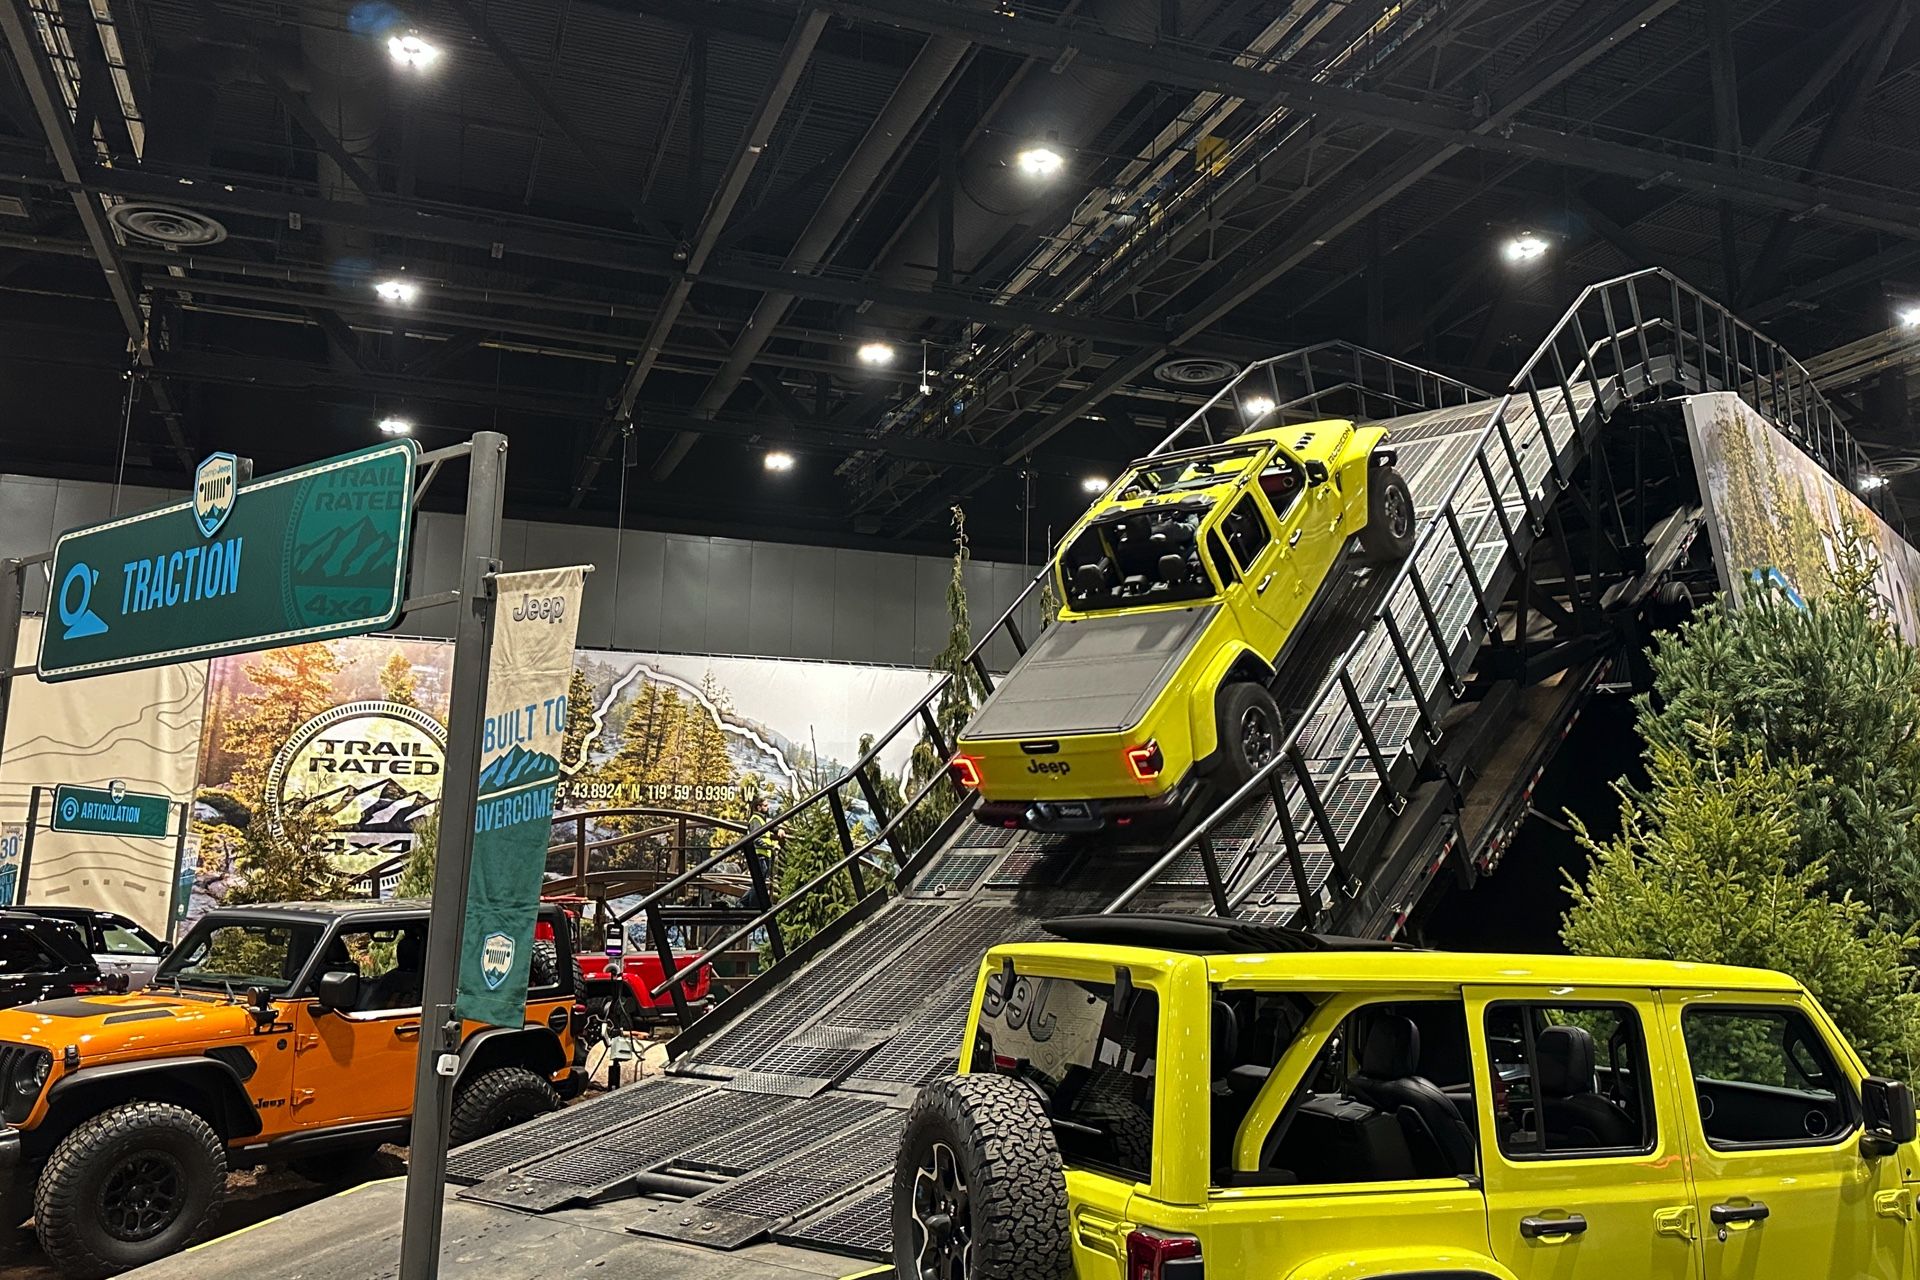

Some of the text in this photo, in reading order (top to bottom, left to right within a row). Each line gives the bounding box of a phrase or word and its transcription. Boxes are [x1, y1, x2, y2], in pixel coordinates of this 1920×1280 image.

[328, 466, 400, 488] TRAIL
[122, 537, 243, 615] TRACTION
[304, 593, 373, 616] 4x4
[513, 594, 566, 624] Jeep
[483, 695, 568, 753] BUILT TO
[317, 739, 434, 758] TRAIL
[309, 757, 440, 776] RATED
[1027, 759, 1070, 775] Jeep
[743, 786, 755, 801] W
[80, 802, 141, 823] ARTICULATION
[475, 786, 555, 833] OVERCOME
[322, 838, 412, 856] 4x4
